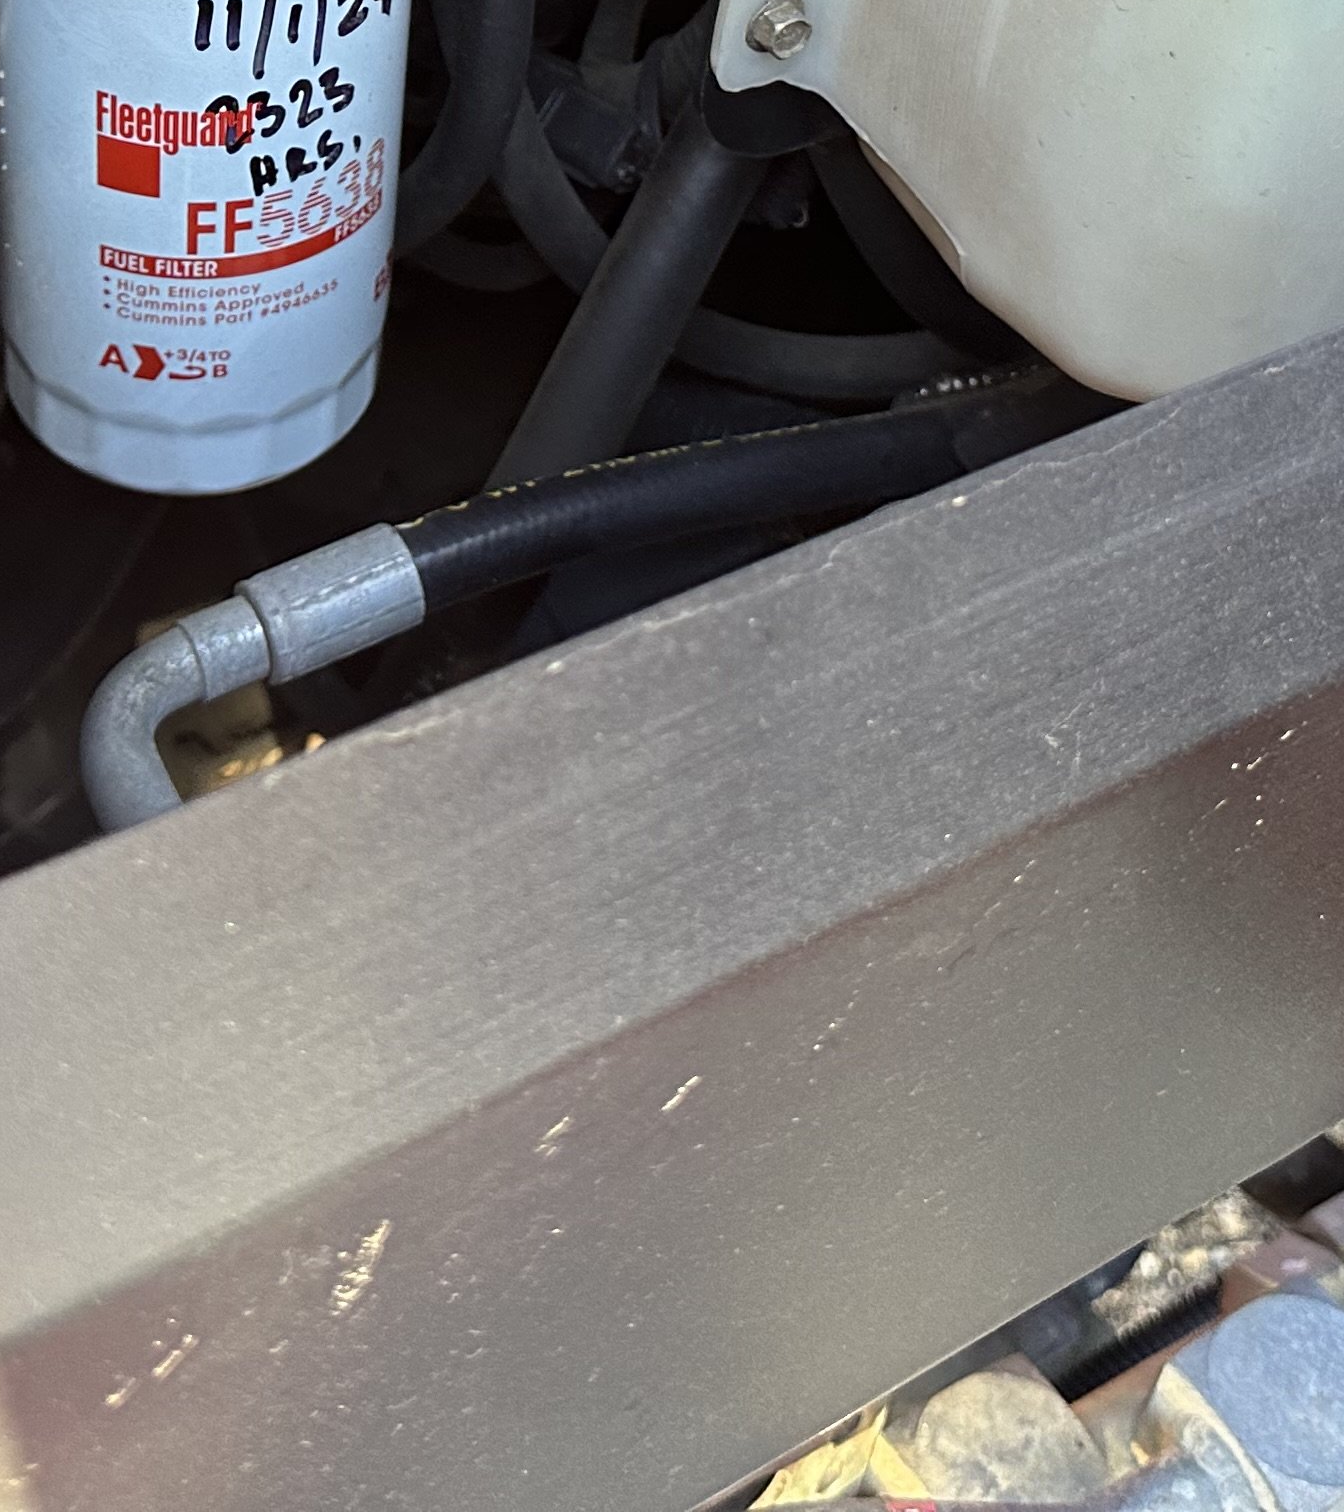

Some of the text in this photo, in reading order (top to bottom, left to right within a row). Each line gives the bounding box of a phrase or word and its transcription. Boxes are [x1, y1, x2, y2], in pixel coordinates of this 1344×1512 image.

[96, 90, 255, 155] Fleetguard
[103, 247, 219, 277] FUEL FILTER
[116, 278, 262, 299] High Efficiency
[116, 281, 306, 313] Cummins Approved
[116, 305, 208, 327] Cummins
[214, 310, 253, 325] Part
[98, 343, 130, 374] A
[209, 349, 232, 362] TO
[212, 363, 229, 378] B
